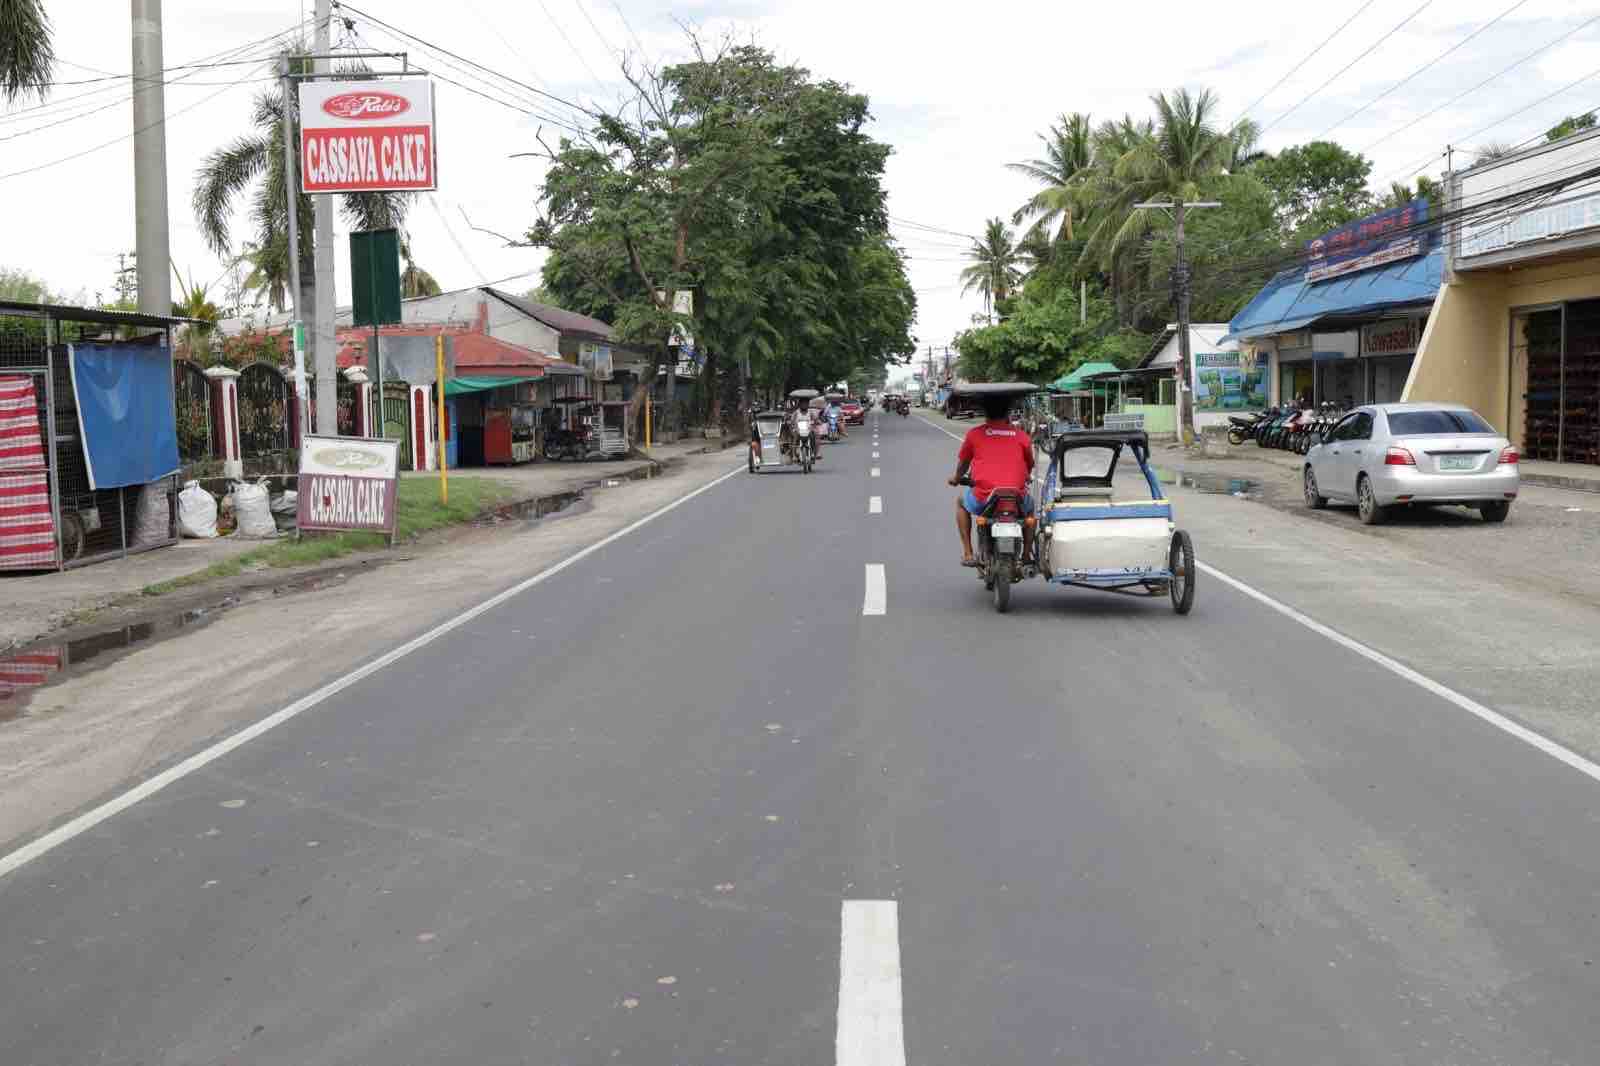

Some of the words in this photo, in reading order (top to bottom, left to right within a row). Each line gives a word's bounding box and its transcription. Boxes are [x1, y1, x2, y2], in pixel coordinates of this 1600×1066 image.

[306, 136, 379, 184] CASSAVA
[381, 134, 427, 182] CAKE
[310, 477, 355, 523] CASSAVA
[357, 480, 385, 525] CAKE
